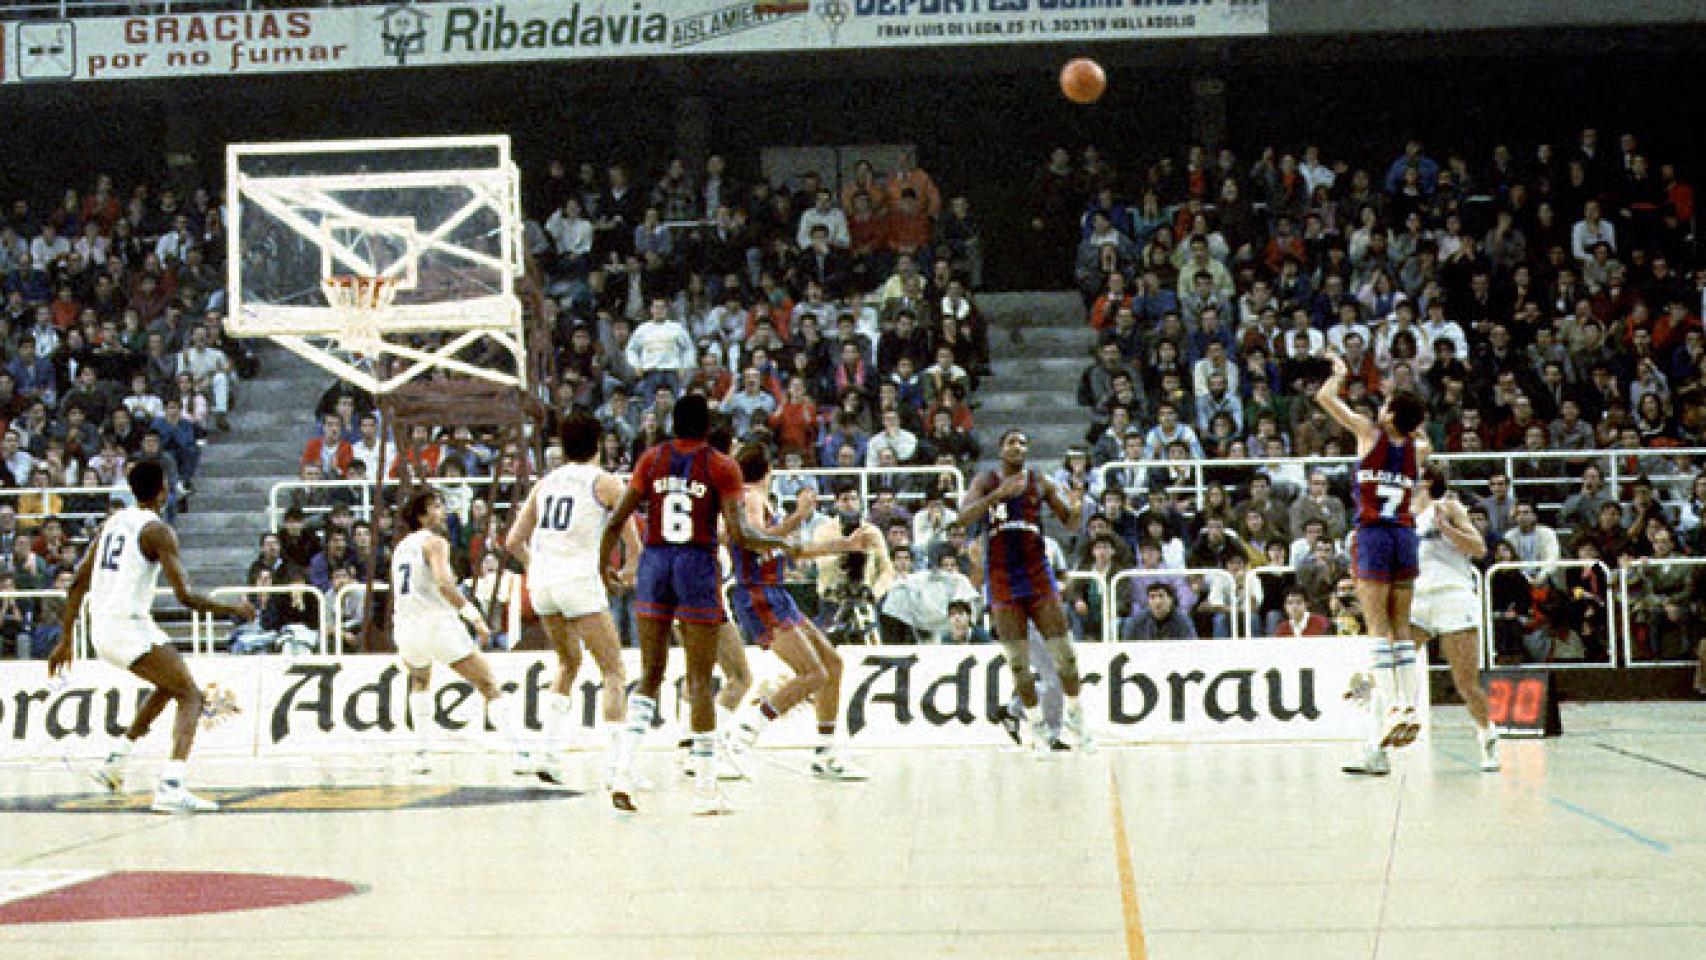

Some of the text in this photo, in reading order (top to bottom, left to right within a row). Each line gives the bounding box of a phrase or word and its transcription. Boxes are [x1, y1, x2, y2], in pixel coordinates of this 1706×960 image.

[124, 12, 312, 45] GRACIAS
[442, 2, 668, 52] Ribadavia
[914, 22, 944, 37] LUIS
[947, 21, 965, 36] DE
[87, 42, 348, 77] por no fumar
[540, 494, 574, 531] 10
[661, 493, 693, 543] 6
[1375, 485, 1404, 518] 7
[102, 533, 126, 571] 12
[399, 562, 413, 595] 7
[846, 651, 1322, 737] Adlbrau
[1487, 678, 1544, 724] 30
[0, 686, 157, 741] rau
